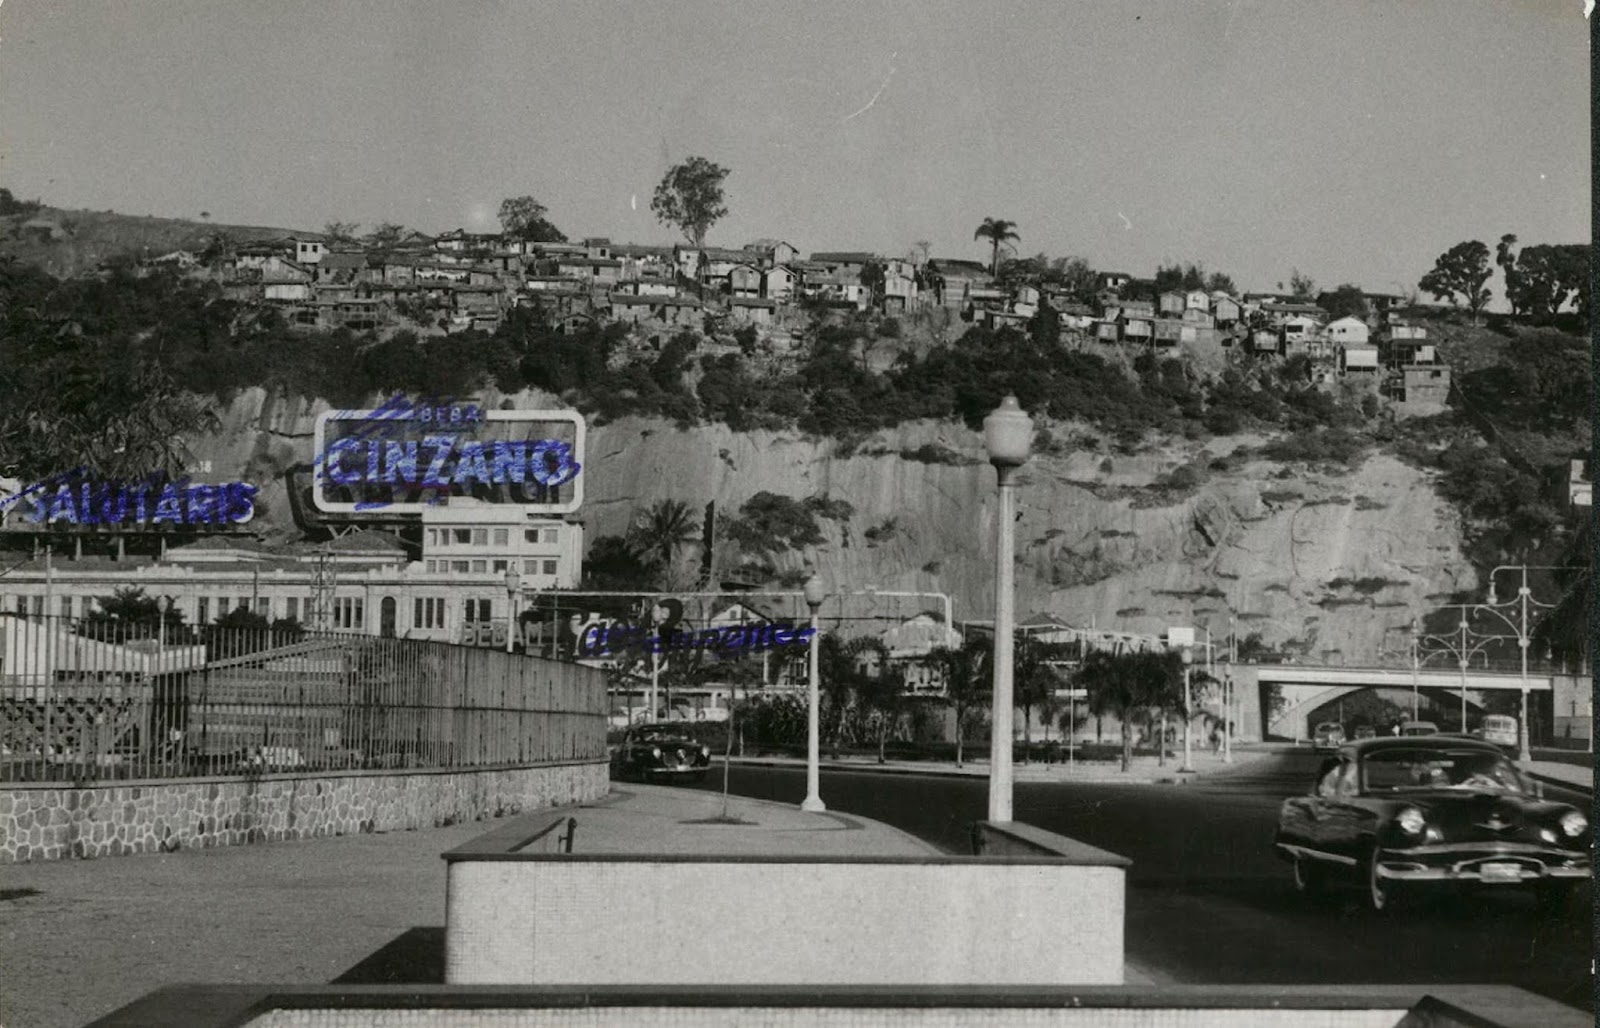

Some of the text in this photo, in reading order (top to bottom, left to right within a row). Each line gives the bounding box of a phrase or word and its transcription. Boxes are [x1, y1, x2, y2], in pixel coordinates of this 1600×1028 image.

[420, 403, 480, 423] BEBA
[327, 435, 571, 485] CINZANO
[22, 481, 255, 524] SALUTARIS
